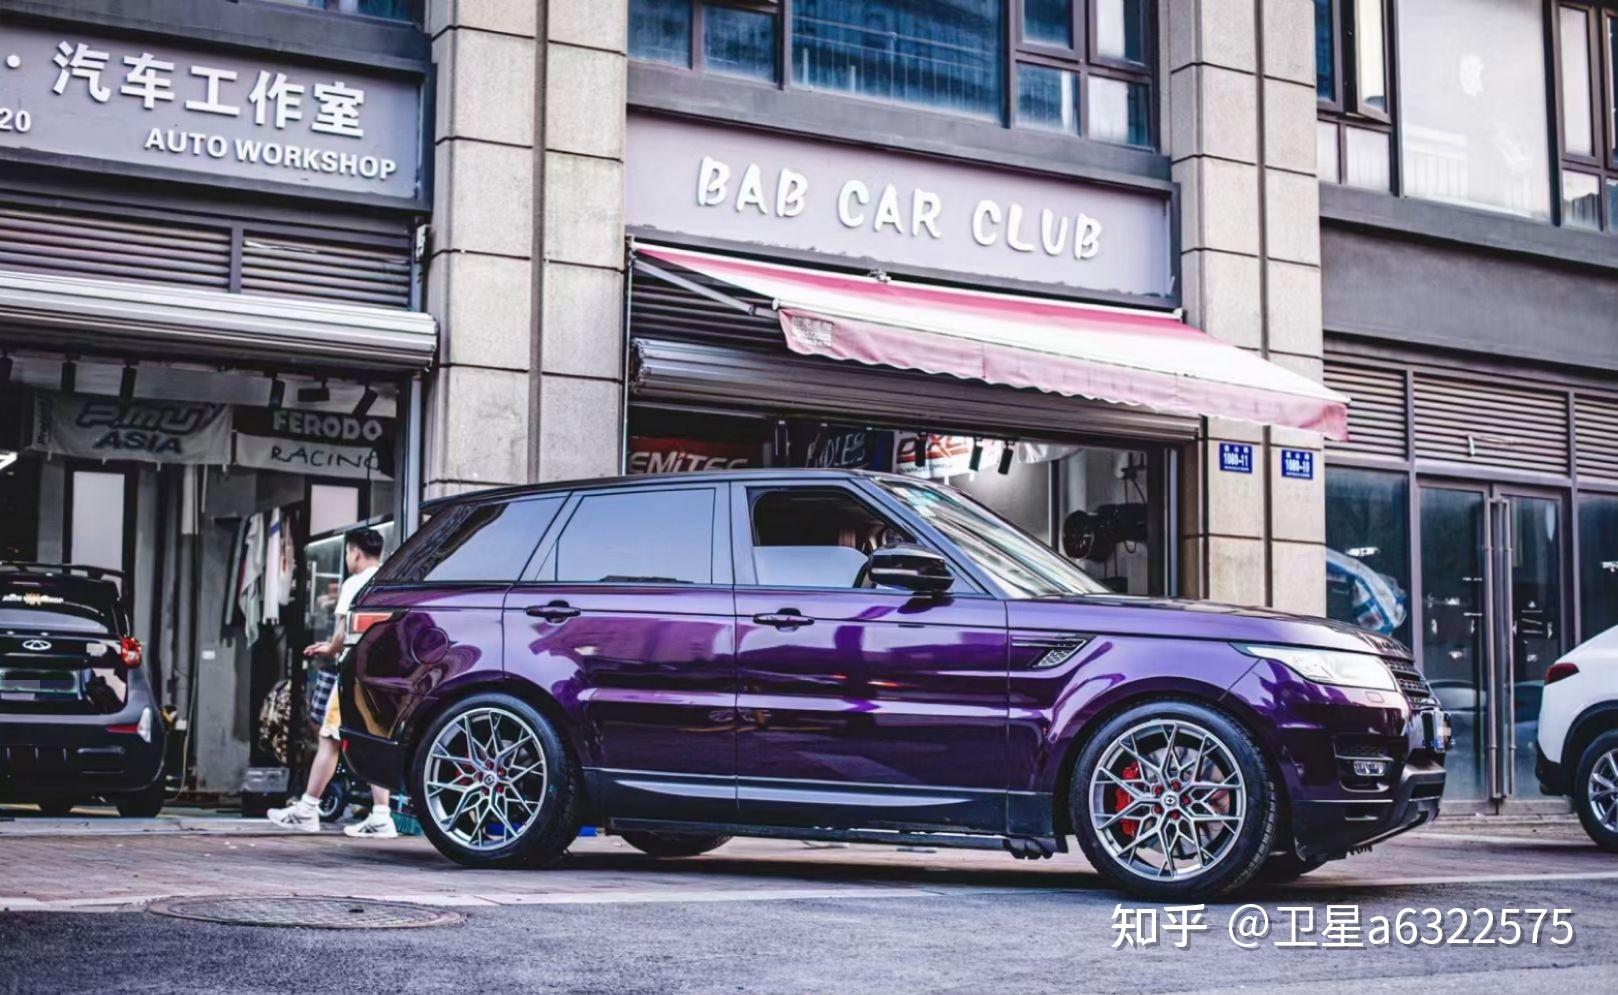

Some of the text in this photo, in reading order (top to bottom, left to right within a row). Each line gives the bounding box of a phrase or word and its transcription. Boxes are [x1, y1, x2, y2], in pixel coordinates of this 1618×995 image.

[52, 41, 364, 138] 汽车工作室
[145, 127, 398, 181] AUTO WORKSHOP
[696, 156, 1103, 260] BAB CAR CLUB
[92, 430, 182, 454] ASIA
[273, 410, 383, 441] FERODO
